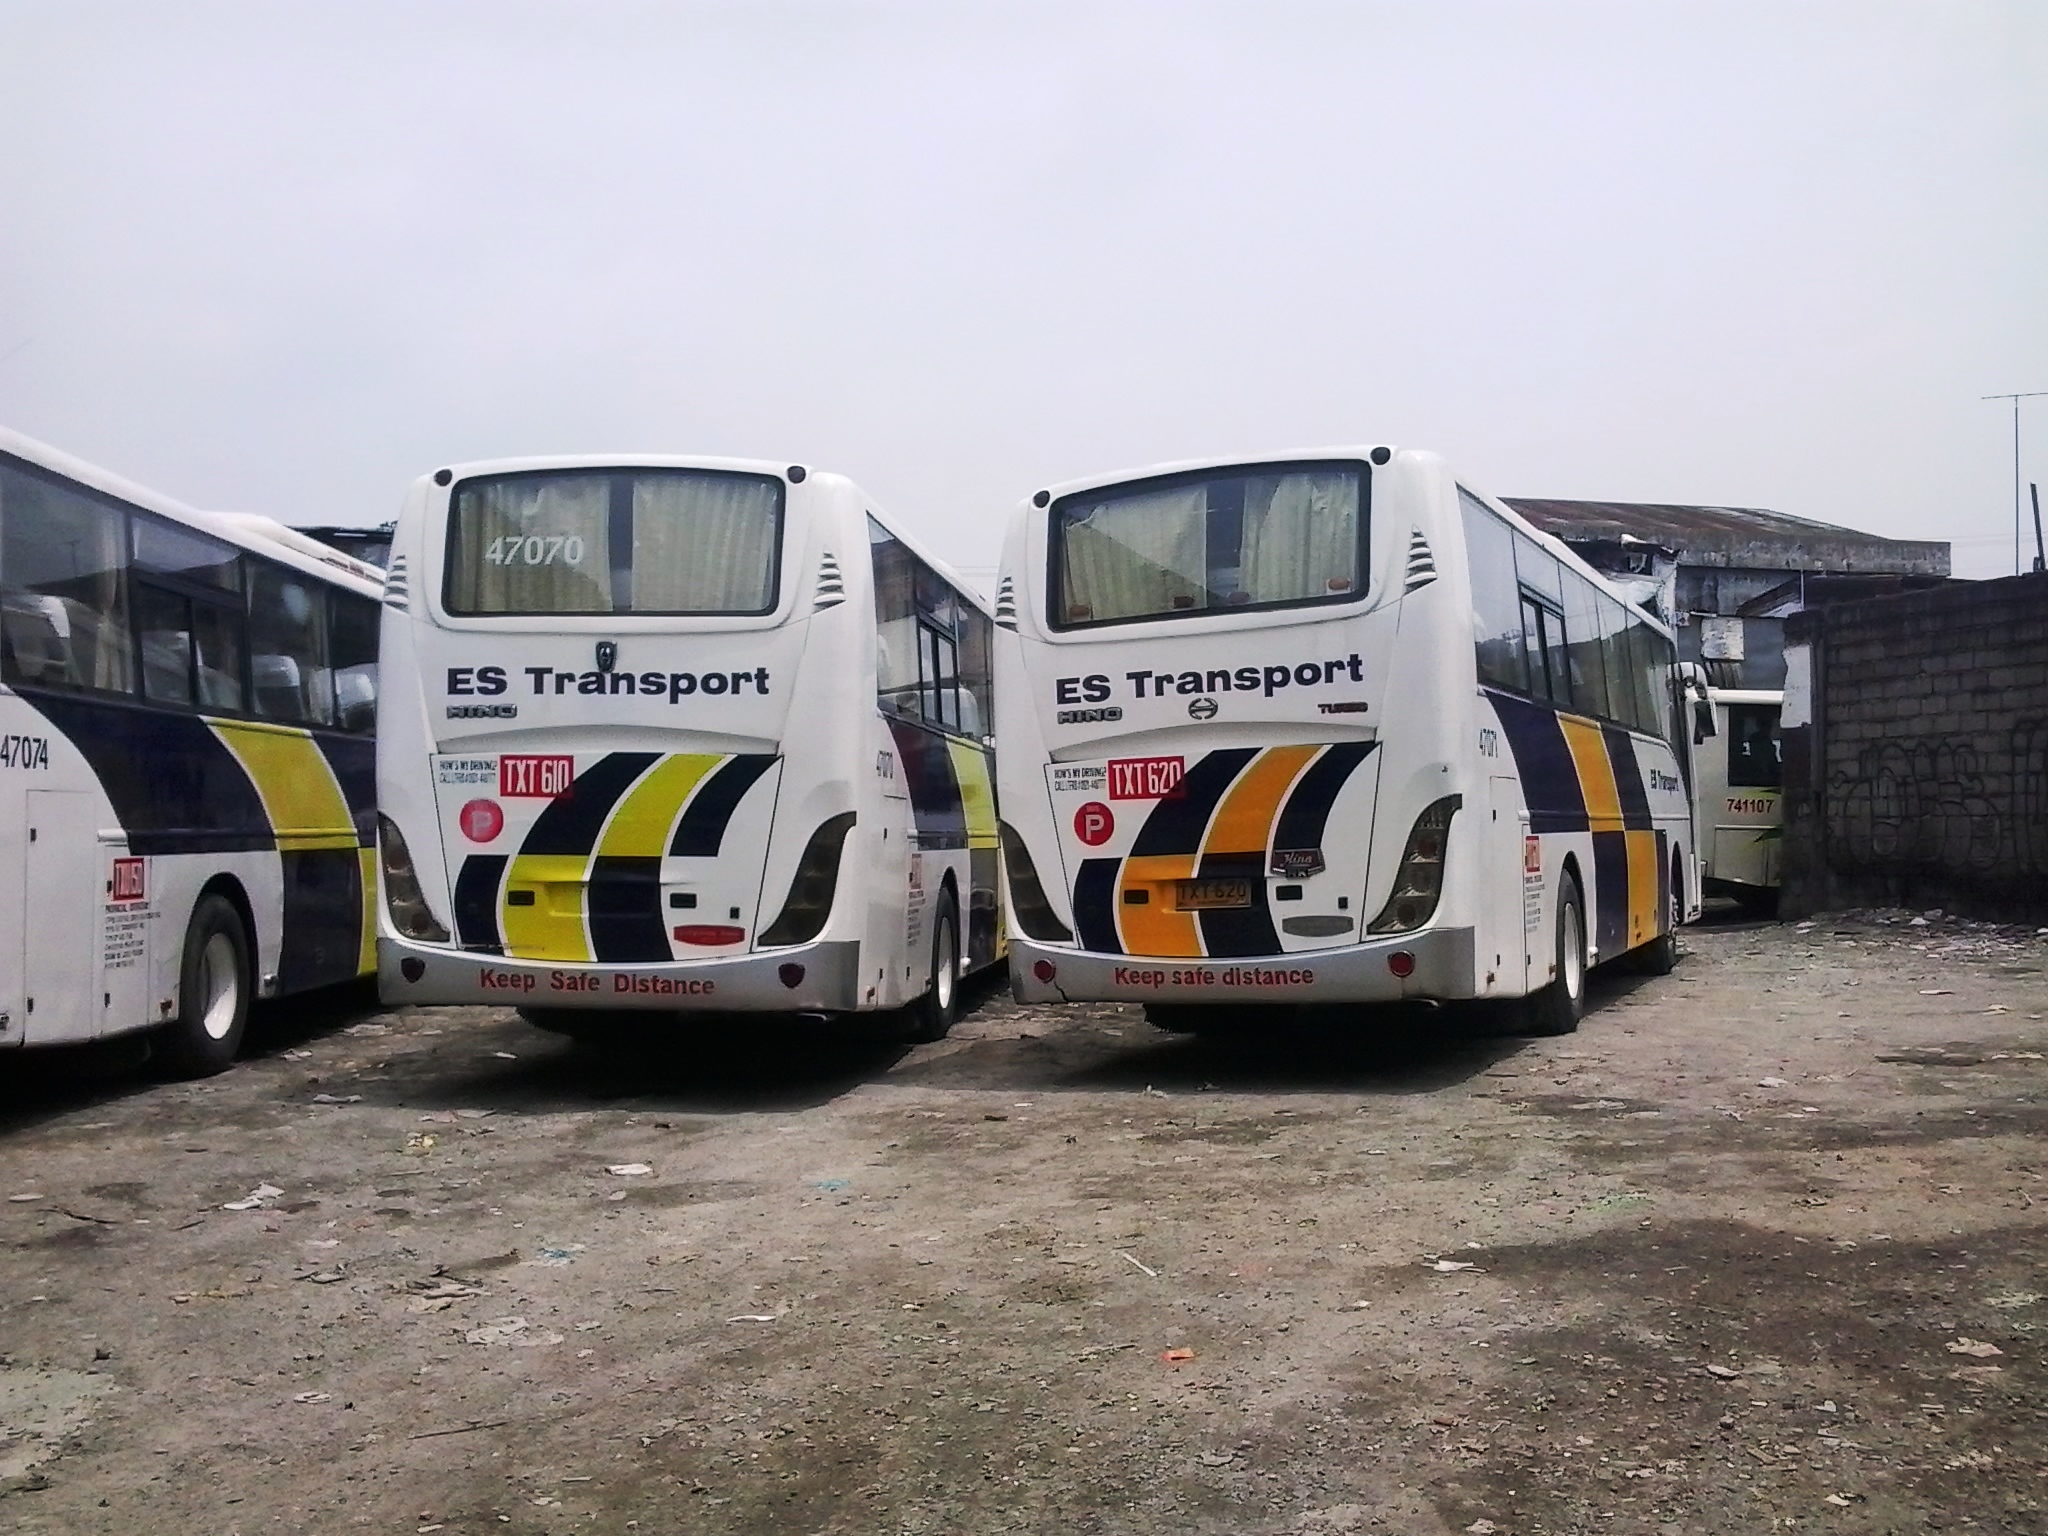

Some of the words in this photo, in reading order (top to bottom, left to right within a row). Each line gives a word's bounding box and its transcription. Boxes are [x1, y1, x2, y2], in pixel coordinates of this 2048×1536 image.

[485, 535, 583, 565] 47070
[447, 666, 508, 695] ES
[525, 667, 770, 705] Transport
[1056, 674, 1112, 705] ES
[1126, 653, 1364, 698] Transport
[446, 703, 518, 719] HINO
[1057, 706, 1123, 724] HINO
[0, 734, 48, 770] 47074
[504, 759, 538, 794] TXT
[541, 759, 569, 794] 610
[1112, 763, 1145, 796] TXT
[1148, 761, 1181, 794] 620
[1727, 798, 1775, 814] 741107
[1085, 814, 1105, 841] P
[480, 968, 536, 994] Keep
[550, 970, 600, 992] Safe
[613, 973, 716, 995] Distance
[1115, 967, 1166, 988] Keep
[1171, 967, 1216, 986] safe
[1222, 967, 1314, 986] distance
